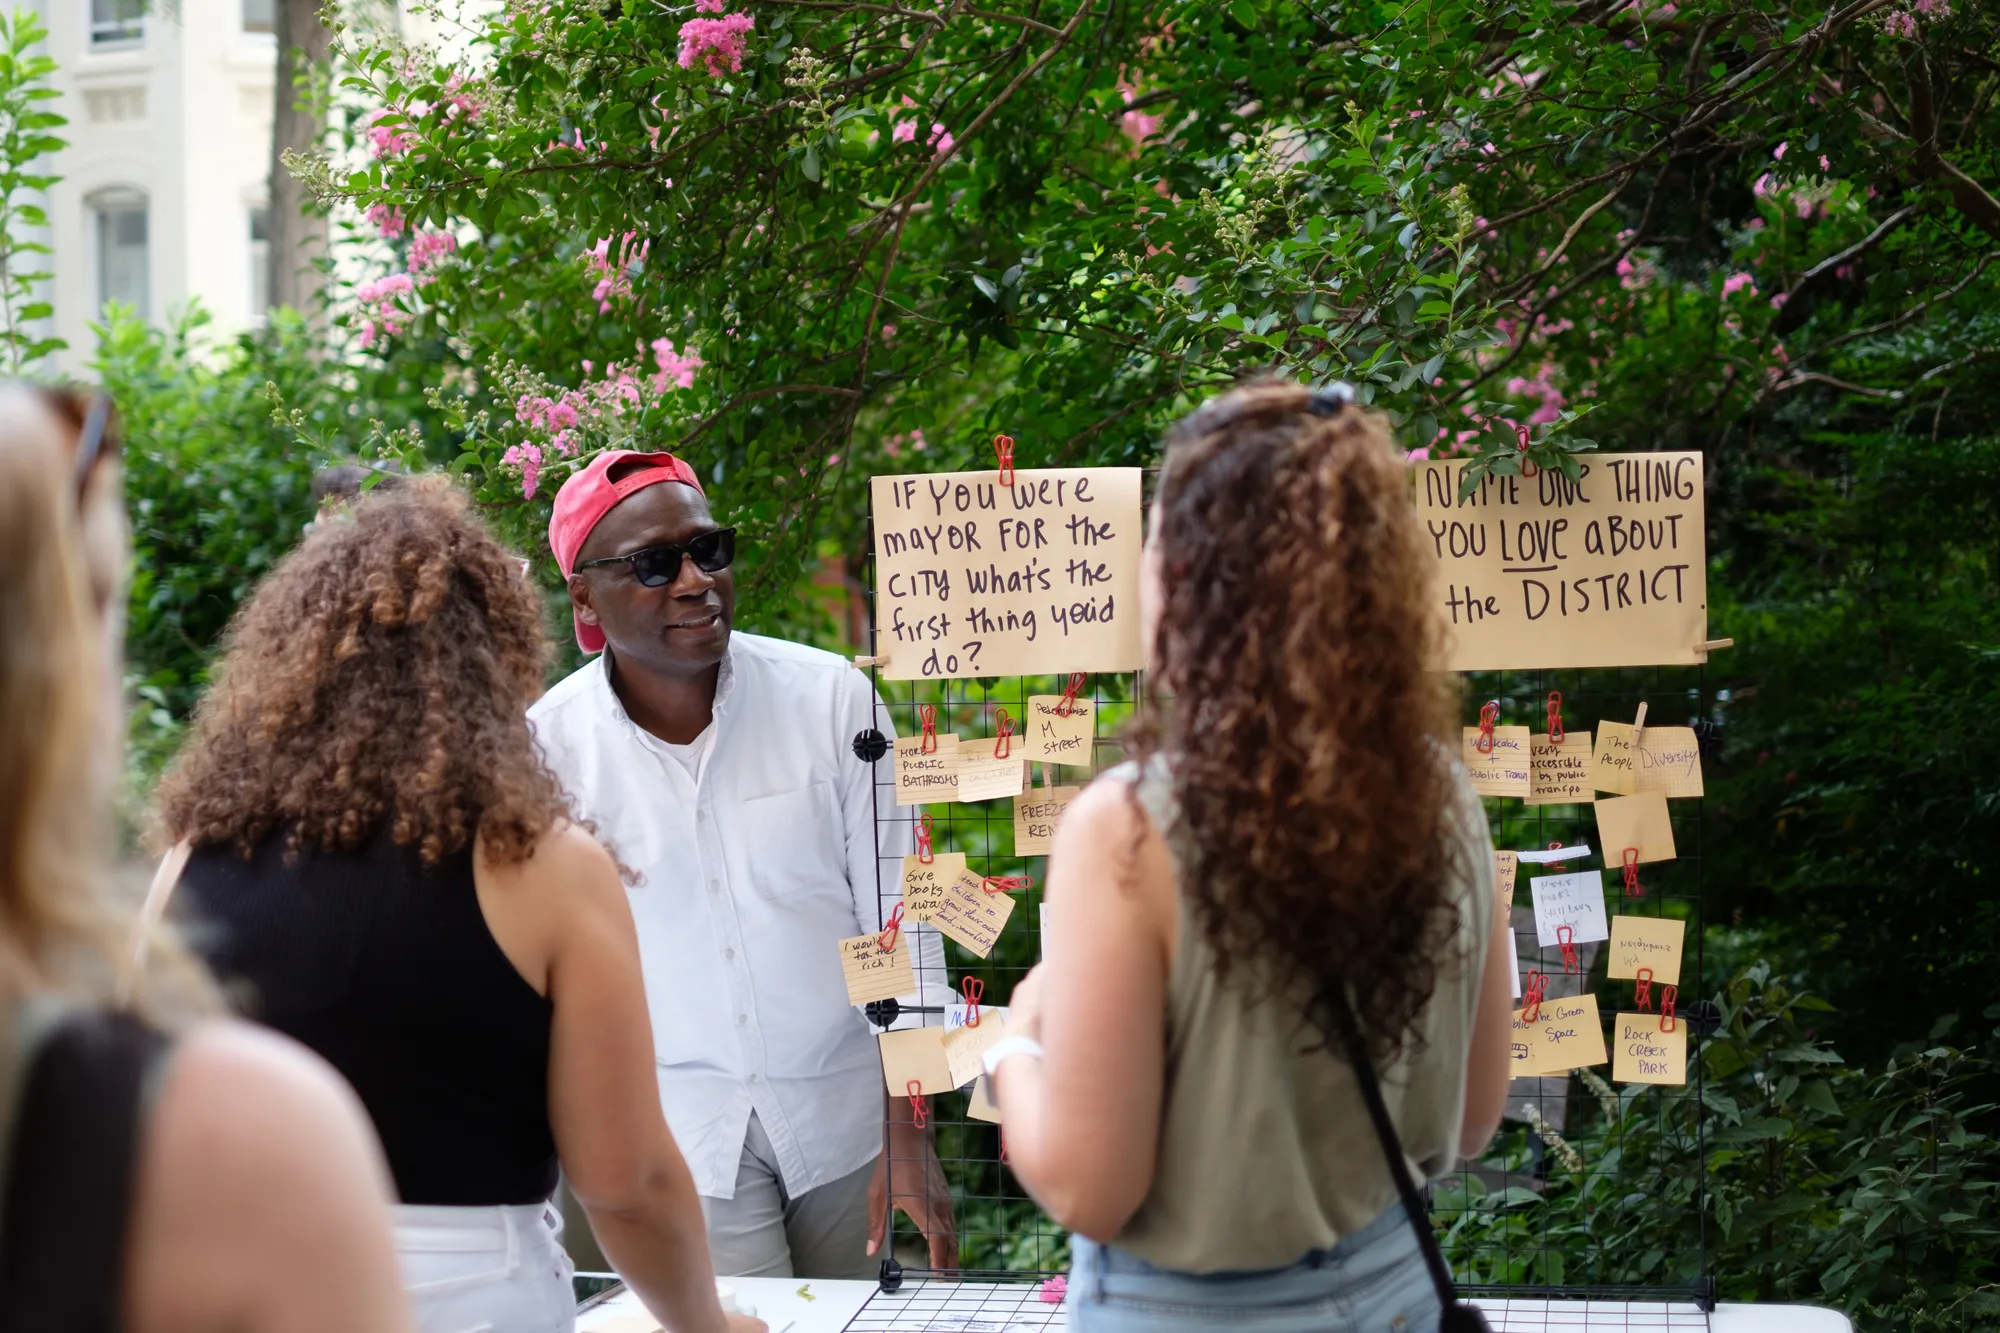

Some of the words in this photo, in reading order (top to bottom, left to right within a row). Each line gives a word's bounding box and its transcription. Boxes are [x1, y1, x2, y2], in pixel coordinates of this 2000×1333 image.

[1606, 457, 1696, 504] THING
[893, 479, 917, 510] IF
[929, 479, 996, 516] YOU
[999, 517, 1049, 552] FOR
[1065, 514, 1116, 547] the
[1427, 519, 1487, 559] YOU
[1065, 559, 1113, 587] the
[1445, 584, 1501, 624] the
[1522, 564, 1690, 621] DISTRICT
[892, 606, 951, 642] first
[965, 606, 1037, 641] thing
[1041, 720, 1056, 738] M
[1470, 736, 1520, 750] Wakable
[1604, 736, 1630, 750] The
[1640, 747, 1698, 777] Diversity
[902, 774, 959, 787] BATHROOMS
[1028, 823, 1059, 838] REN
[911, 900, 942, 911] awa
[851, 936, 882, 952] woul
[1555, 1006, 1585, 1020] Green
[1624, 1025, 1654, 1041] ROCK
[1639, 1060, 1668, 1075] PARK
